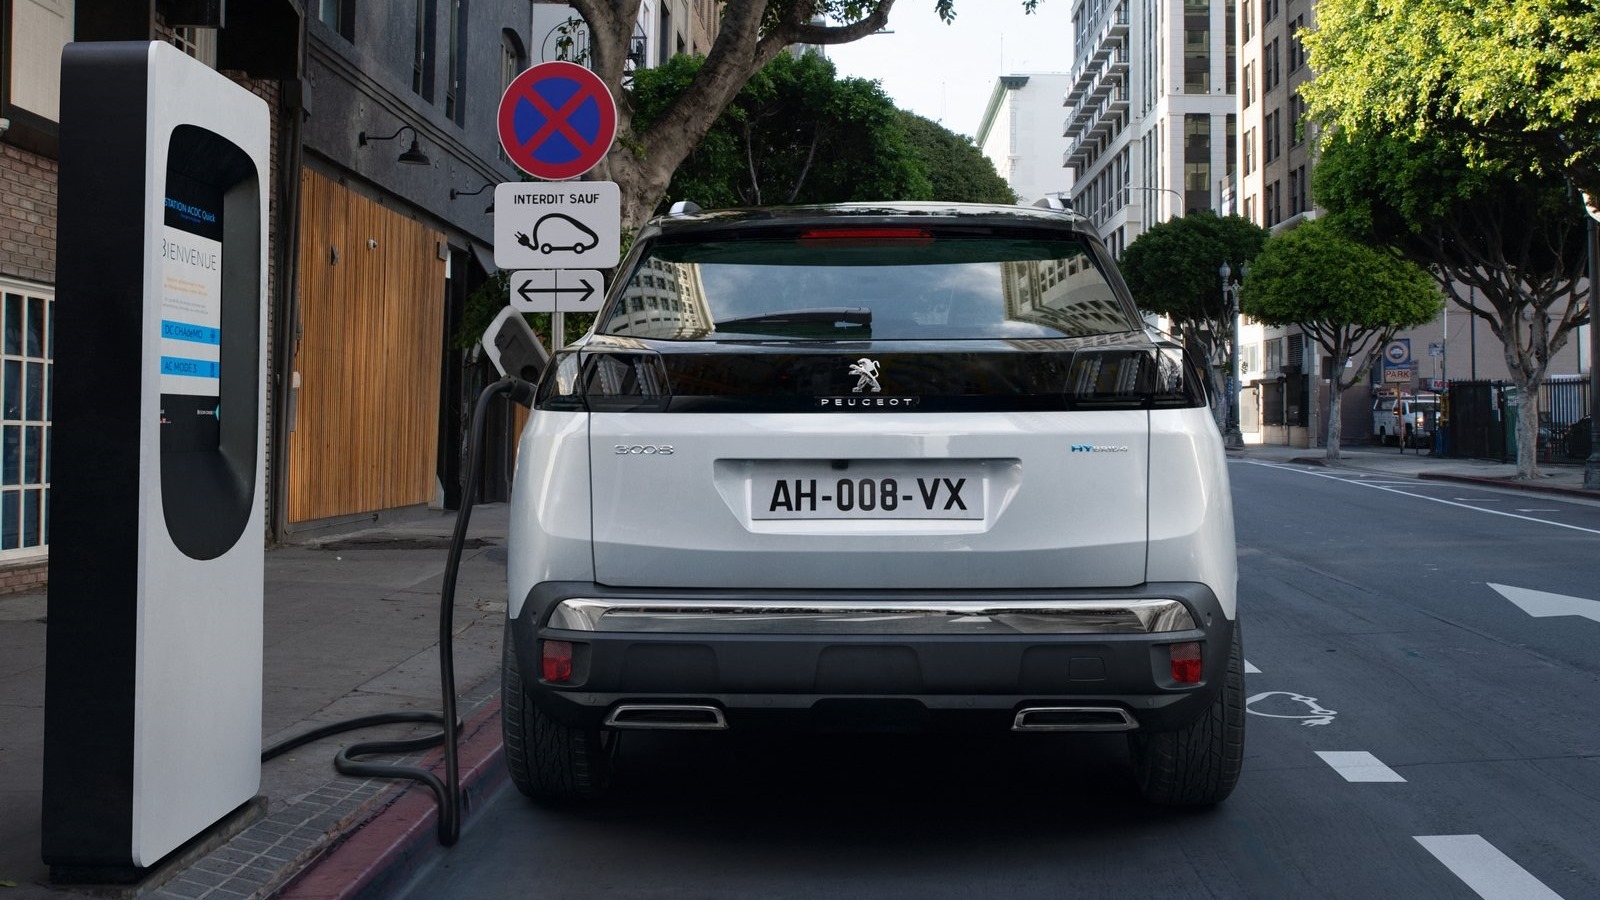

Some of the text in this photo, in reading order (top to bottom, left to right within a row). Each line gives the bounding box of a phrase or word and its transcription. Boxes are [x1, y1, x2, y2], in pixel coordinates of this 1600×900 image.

[514, 194, 600, 204] INTERDIT SAUF
[163, 198, 187, 213] STATION
[187, 205, 202, 218] ACDC
[201, 210, 216, 223] Quick
[164, 324, 175, 335] DC
[164, 361, 173, 371] AC
[173, 362, 192, 374] MODE
[1385, 370, 1410, 378] PARK
[821, 398, 912, 406] PEUGEOT
[614, 444, 674, 455] 3008
[769, 478, 967, 511] AH-008-VX
